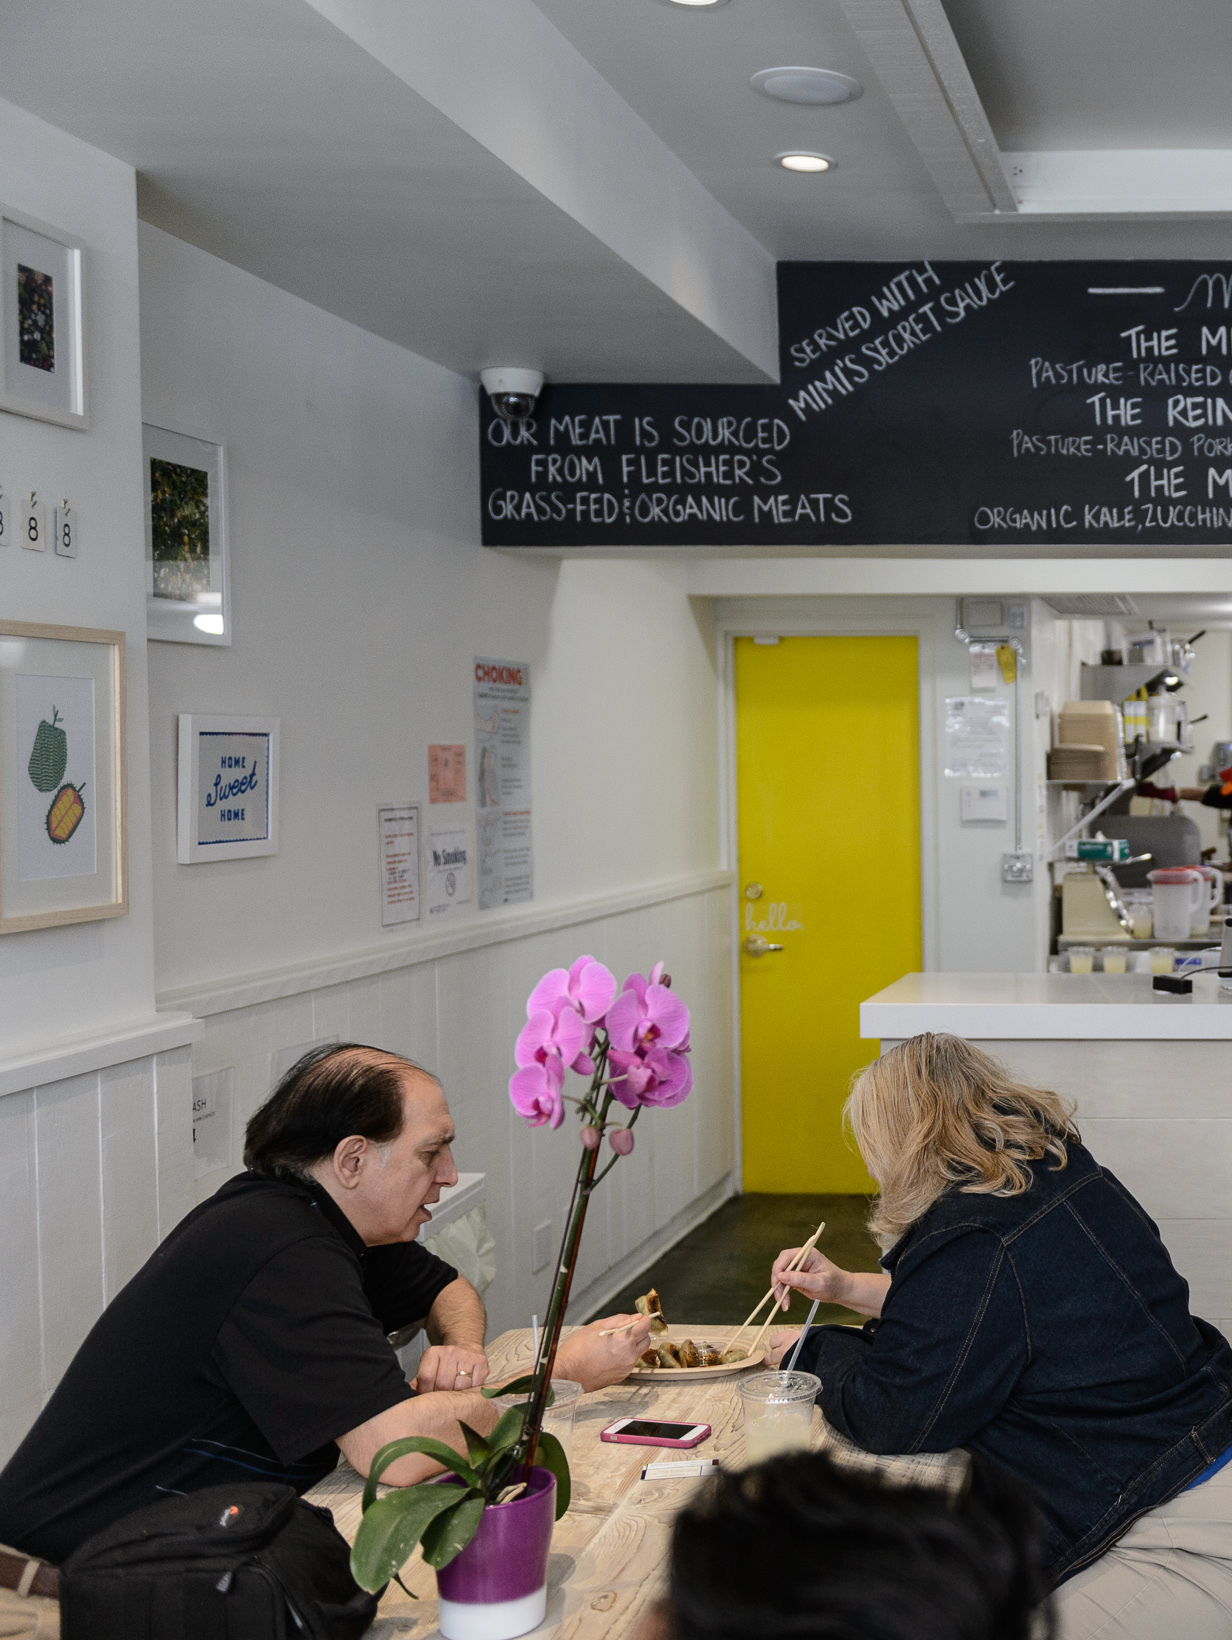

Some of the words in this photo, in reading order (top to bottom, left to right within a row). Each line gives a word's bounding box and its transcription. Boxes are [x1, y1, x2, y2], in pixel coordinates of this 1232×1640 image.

[790, 306, 871, 367] SERVED
[871, 260, 941, 318] WITH
[788, 354, 869, 422] MIMI'S
[861, 302, 942, 371] SECRET
[940, 261, 1015, 323] SAUCE
[1120, 324, 1179, 359] THE
[1029, 355, 1222, 388] PASTURE-RAISED
[1086, 392, 1142, 426] THE
[486, 417, 539, 448] OUR
[550, 414, 622, 445] MEAT
[635, 416, 659, 447] IS
[673, 416, 790, 451] SOURCED
[1010, 429, 1182, 459] PASTURE-RAISED
[531, 454, 603, 485] FROM
[621, 454, 782, 485] FLEISHER'S
[1125, 464, 1188, 499] THE
[489, 488, 619, 524] GRASS-FED
[634, 493, 744, 523] ORGANIC
[753, 493, 852, 524] MEATS
[974, 505, 1077, 531] ORGANIC
[1084, 504, 1144, 531] KALE,
[28, 516, 39, 542] 8
[62, 523, 71, 547] 8
[474, 663, 523, 687] CHOKING
[220, 756, 246, 769] HOME
[205, 760, 258, 807] Sweet
[220, 808, 246, 822] HOME
